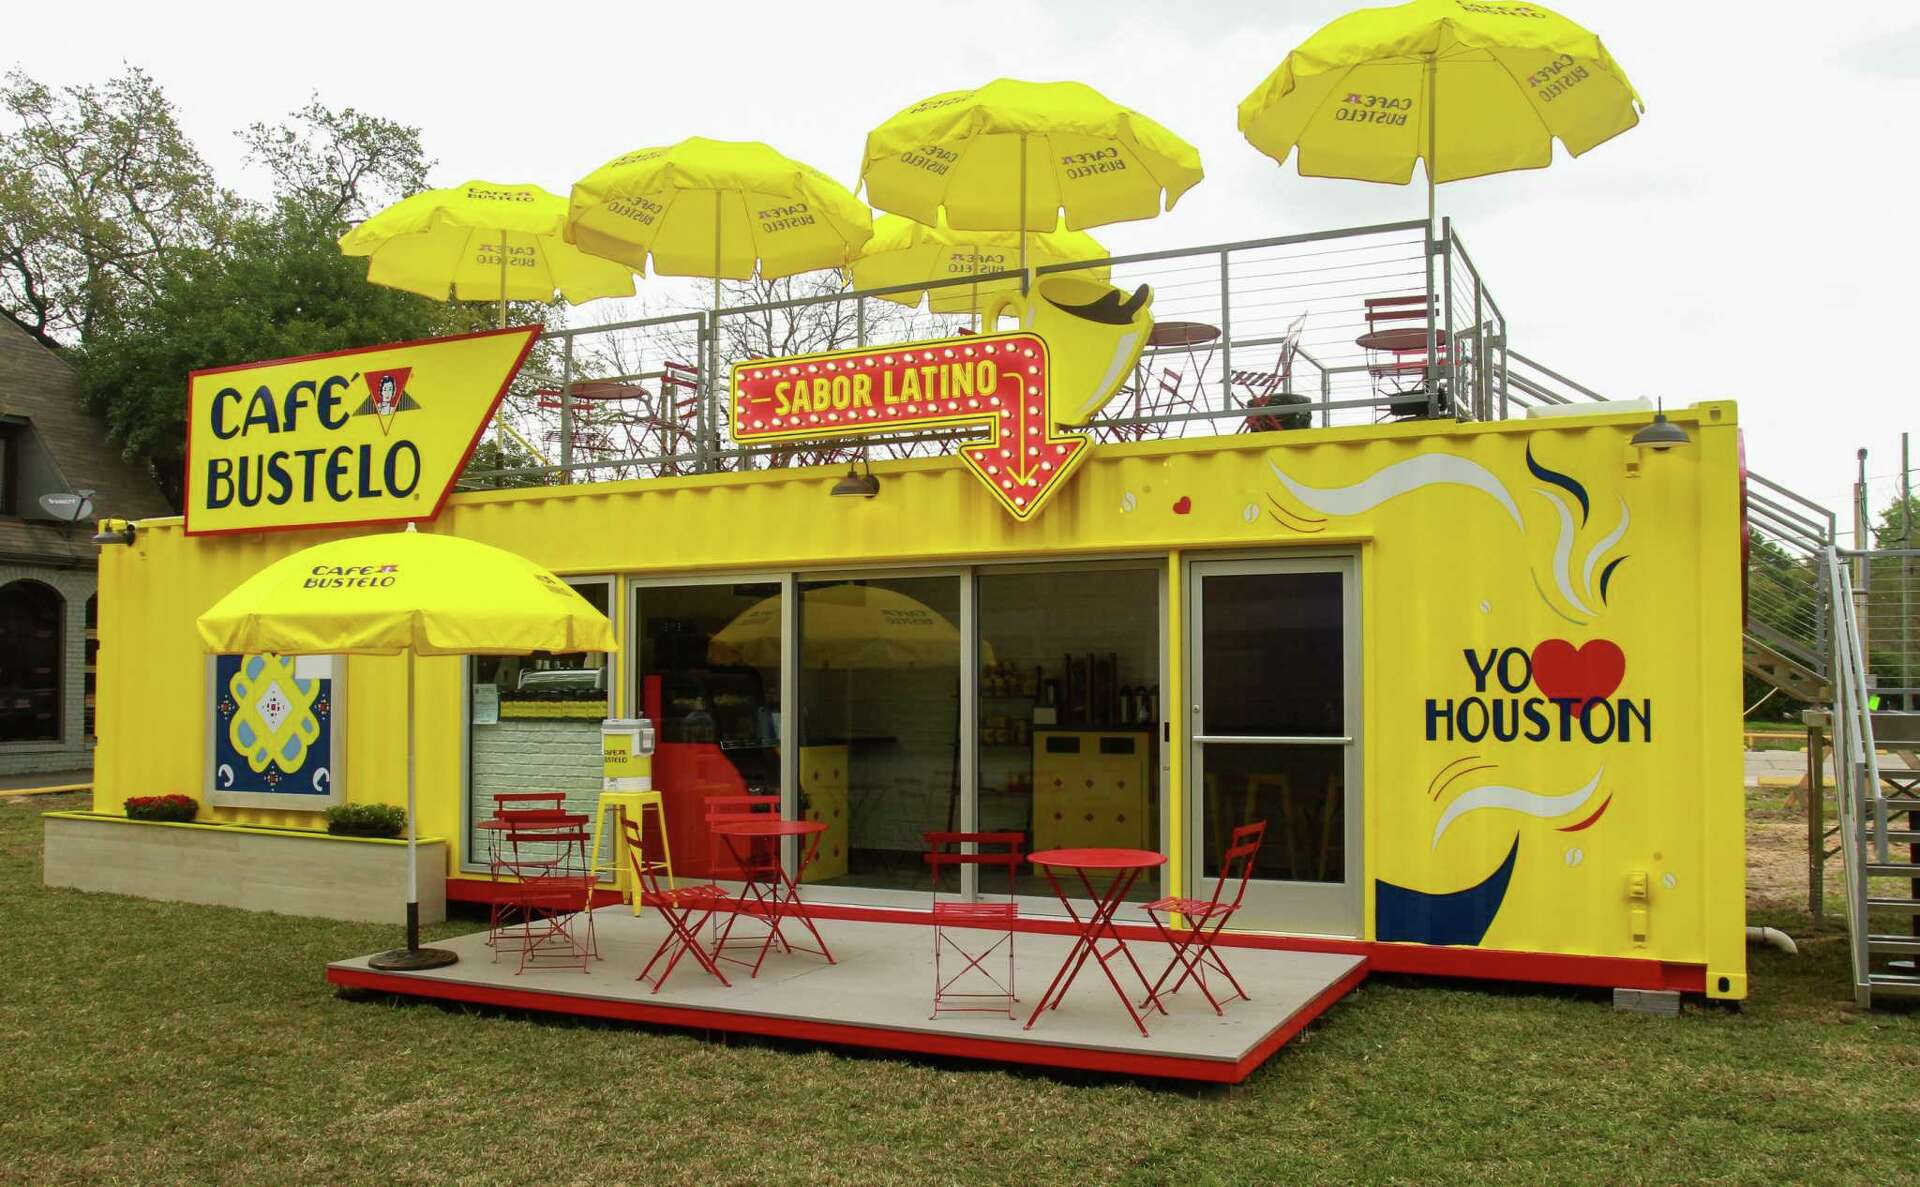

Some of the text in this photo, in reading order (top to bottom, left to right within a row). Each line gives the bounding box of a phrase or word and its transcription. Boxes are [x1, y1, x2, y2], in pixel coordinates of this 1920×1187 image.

[210, 372, 360, 440] CAFÉ
[774, 359, 998, 416] SABOR LATINO
[206, 440, 421, 510] BUSTELO
[303, 576, 396, 588] BUSTELO
[312, 565, 375, 576] CAFE
[1463, 647, 1533, 694] YO
[1425, 697, 1653, 743] HOUSTON
